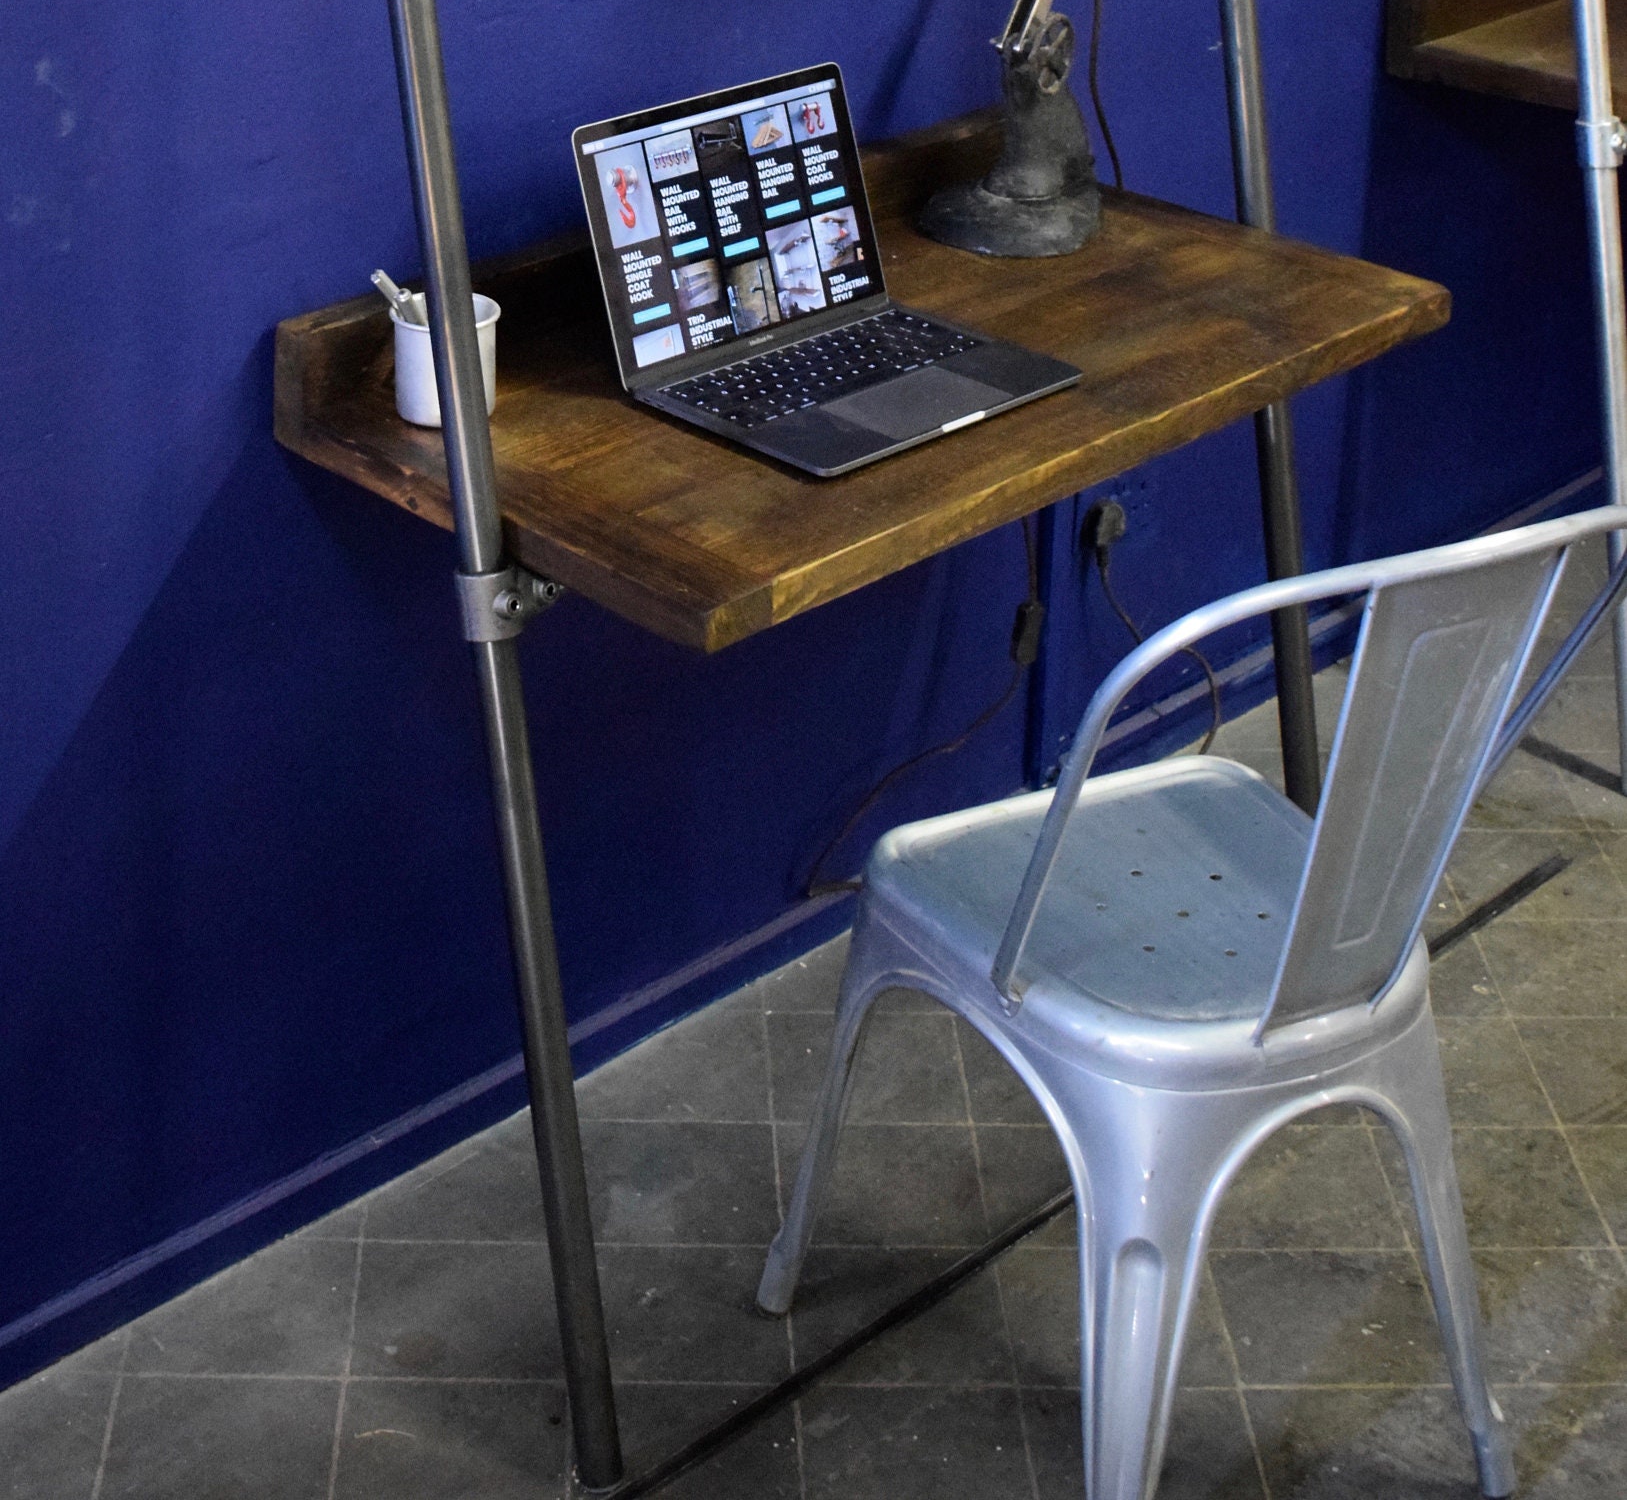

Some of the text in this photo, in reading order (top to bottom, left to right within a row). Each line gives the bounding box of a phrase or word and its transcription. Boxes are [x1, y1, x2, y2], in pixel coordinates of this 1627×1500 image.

[802, 144, 822, 157] WALL
[756, 158, 777, 170] WALL
[804, 150, 838, 166] MOUNTED
[758, 162, 794, 180] MOUNTED
[806, 162, 826, 176] COAT
[710, 176, 732, 188] WALL
[760, 172, 794, 190] HANGING
[808, 171, 834, 186] HOOKS
[660, 184, 682, 197] WALL
[712, 180, 748, 198] MOUNTED
[762, 187, 779, 199] RAIL
[662, 190, 700, 208] MOUNTED
[714, 190, 748, 208] HANGING
[664, 205, 682, 217] RAIL
[716, 206, 733, 218] RAIL
[666, 213, 688, 226] WITH
[718, 214, 738, 227] WITH
[668, 221, 696, 236] HOOKS
[720, 223, 742, 237] SHELF
[621, 250, 644, 264] WALL
[624, 255, 662, 274] MOUNTED
[626, 268, 652, 284] SINGLE
[828, 273, 846, 286] TRIO
[628, 280, 650, 293] COAT
[630, 289, 654, 304] HOOK
[686, 313, 706, 326] TRIO
[688, 315, 732, 336] INDUSTRIAL
[691, 332, 714, 346] STYLE
